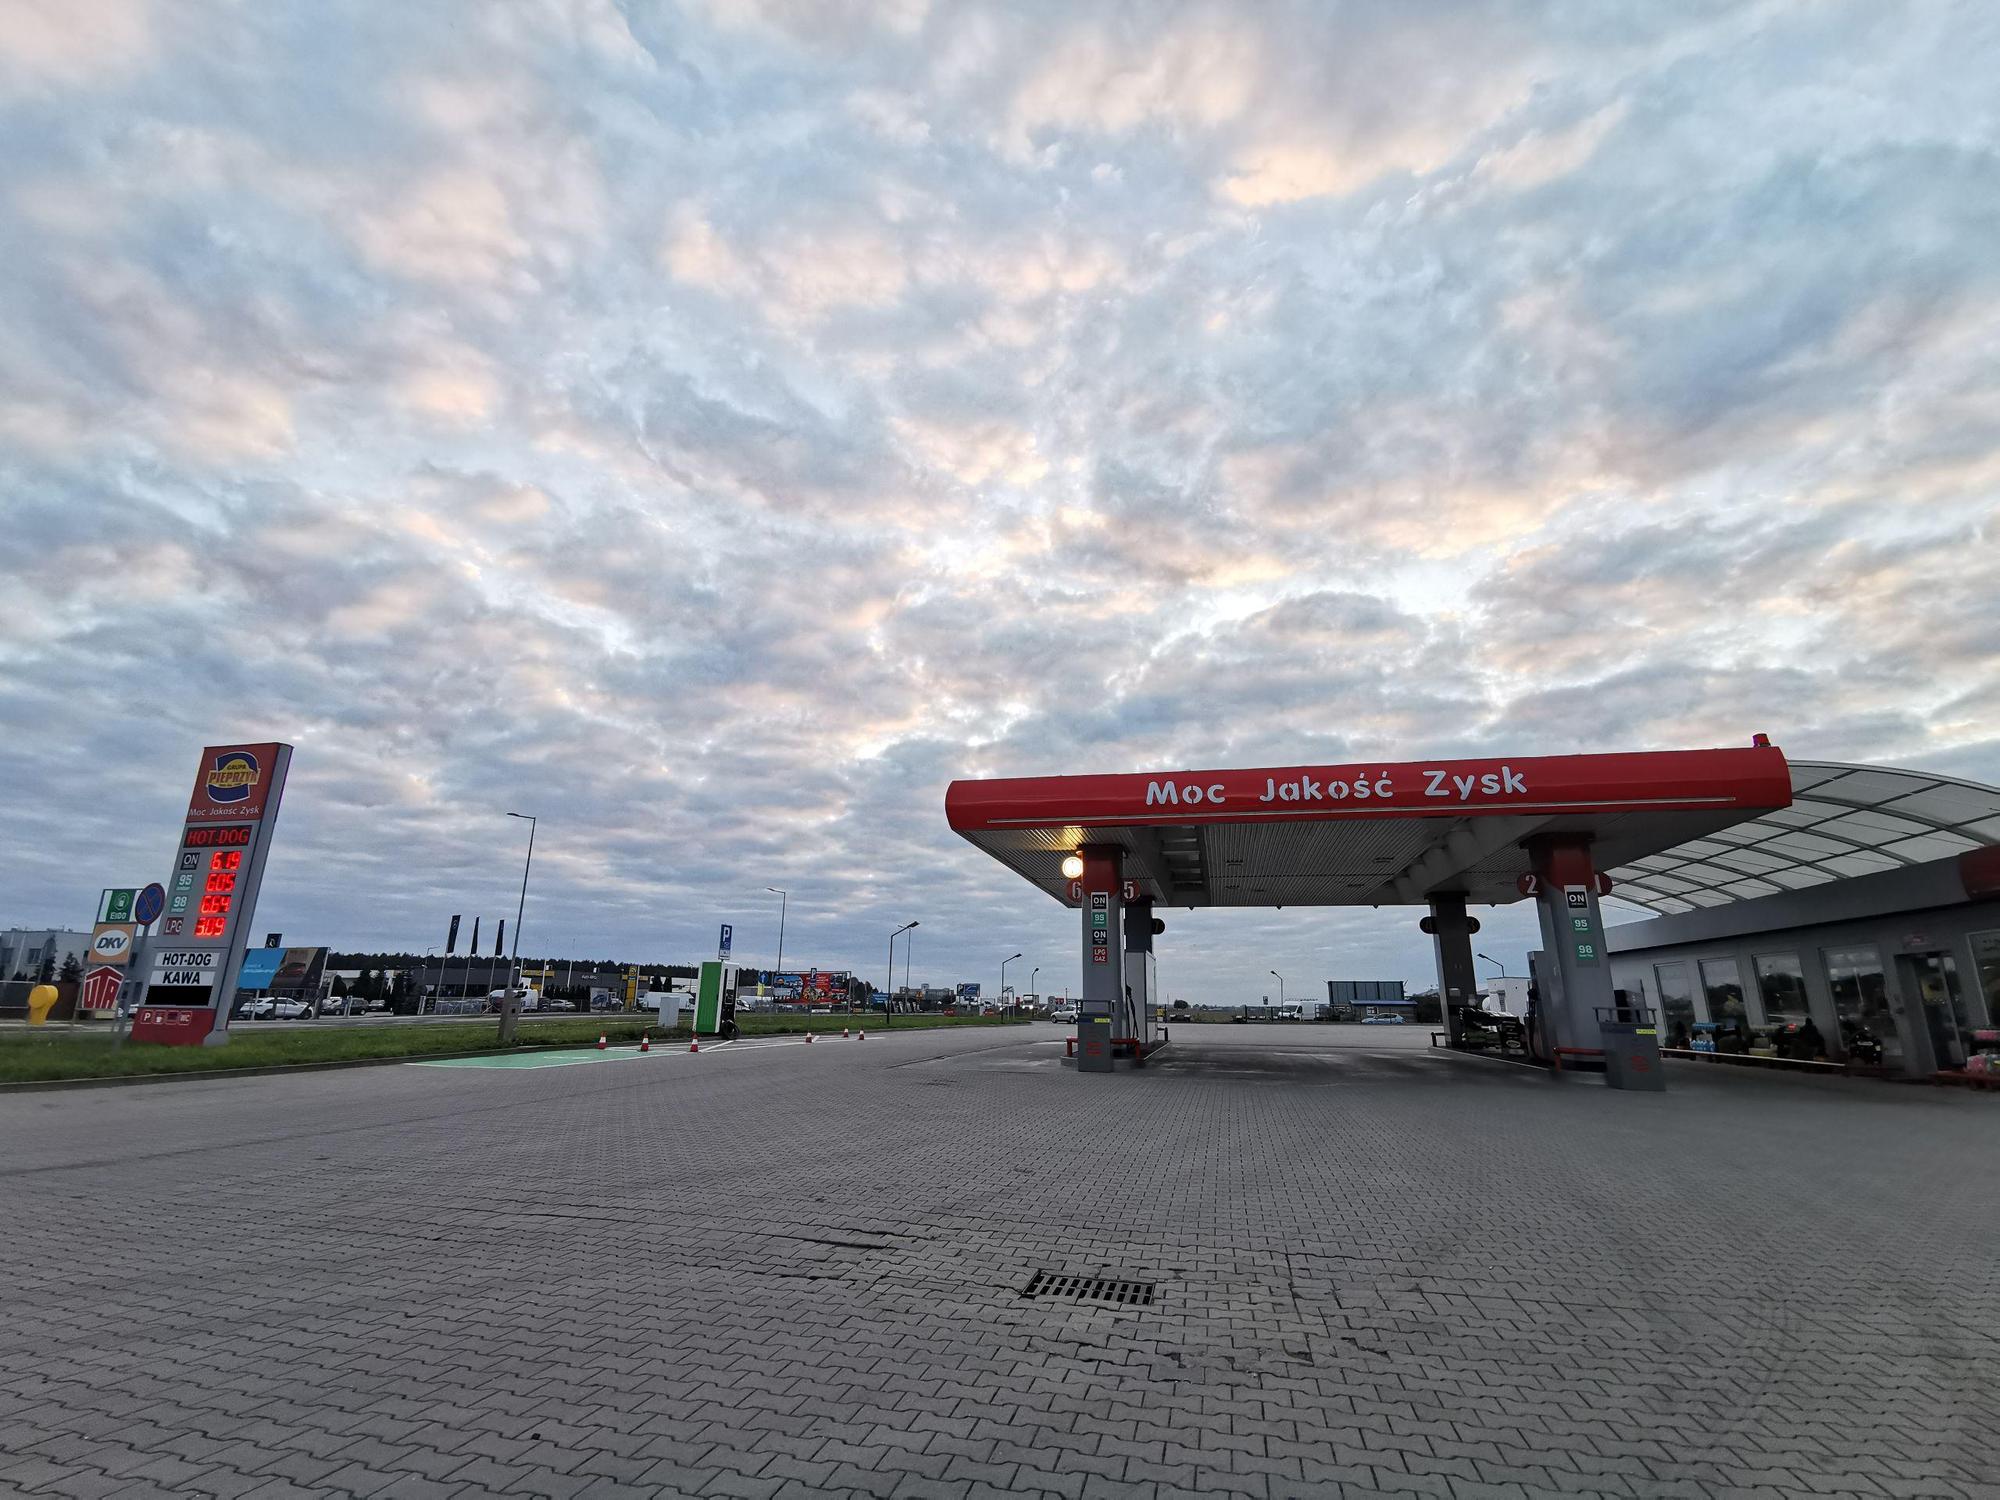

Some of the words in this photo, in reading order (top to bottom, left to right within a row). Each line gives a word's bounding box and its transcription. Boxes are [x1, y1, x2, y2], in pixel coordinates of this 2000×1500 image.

[1145, 780, 1226, 806] Moc
[1259, 770, 1394, 802] Jakość
[1423, 765, 1529, 801] Zysk
[189, 808, 206, 816] Moc
[240, 805, 259, 817] Zysk
[183, 854, 199, 865] ON
[178, 874, 193, 886] 95
[1525, 874, 1538, 894] 2
[1072, 881, 1082, 899] 6
[1123, 881, 1135, 899] 5
[173, 896, 188, 908] 98
[1093, 897, 1106, 905] ON
[1568, 894, 1585, 903] ON
[165, 920, 182, 933] LPG
[1574, 919, 1588, 928] 95
[722, 926, 731, 942] P
[96, 937, 127, 949] DKV
[1578, 945, 1593, 954] 98
[162, 953, 212, 966] HOT-DOG
[162, 971, 201, 985] KAWA
[143, 1012, 151, 1021] P
